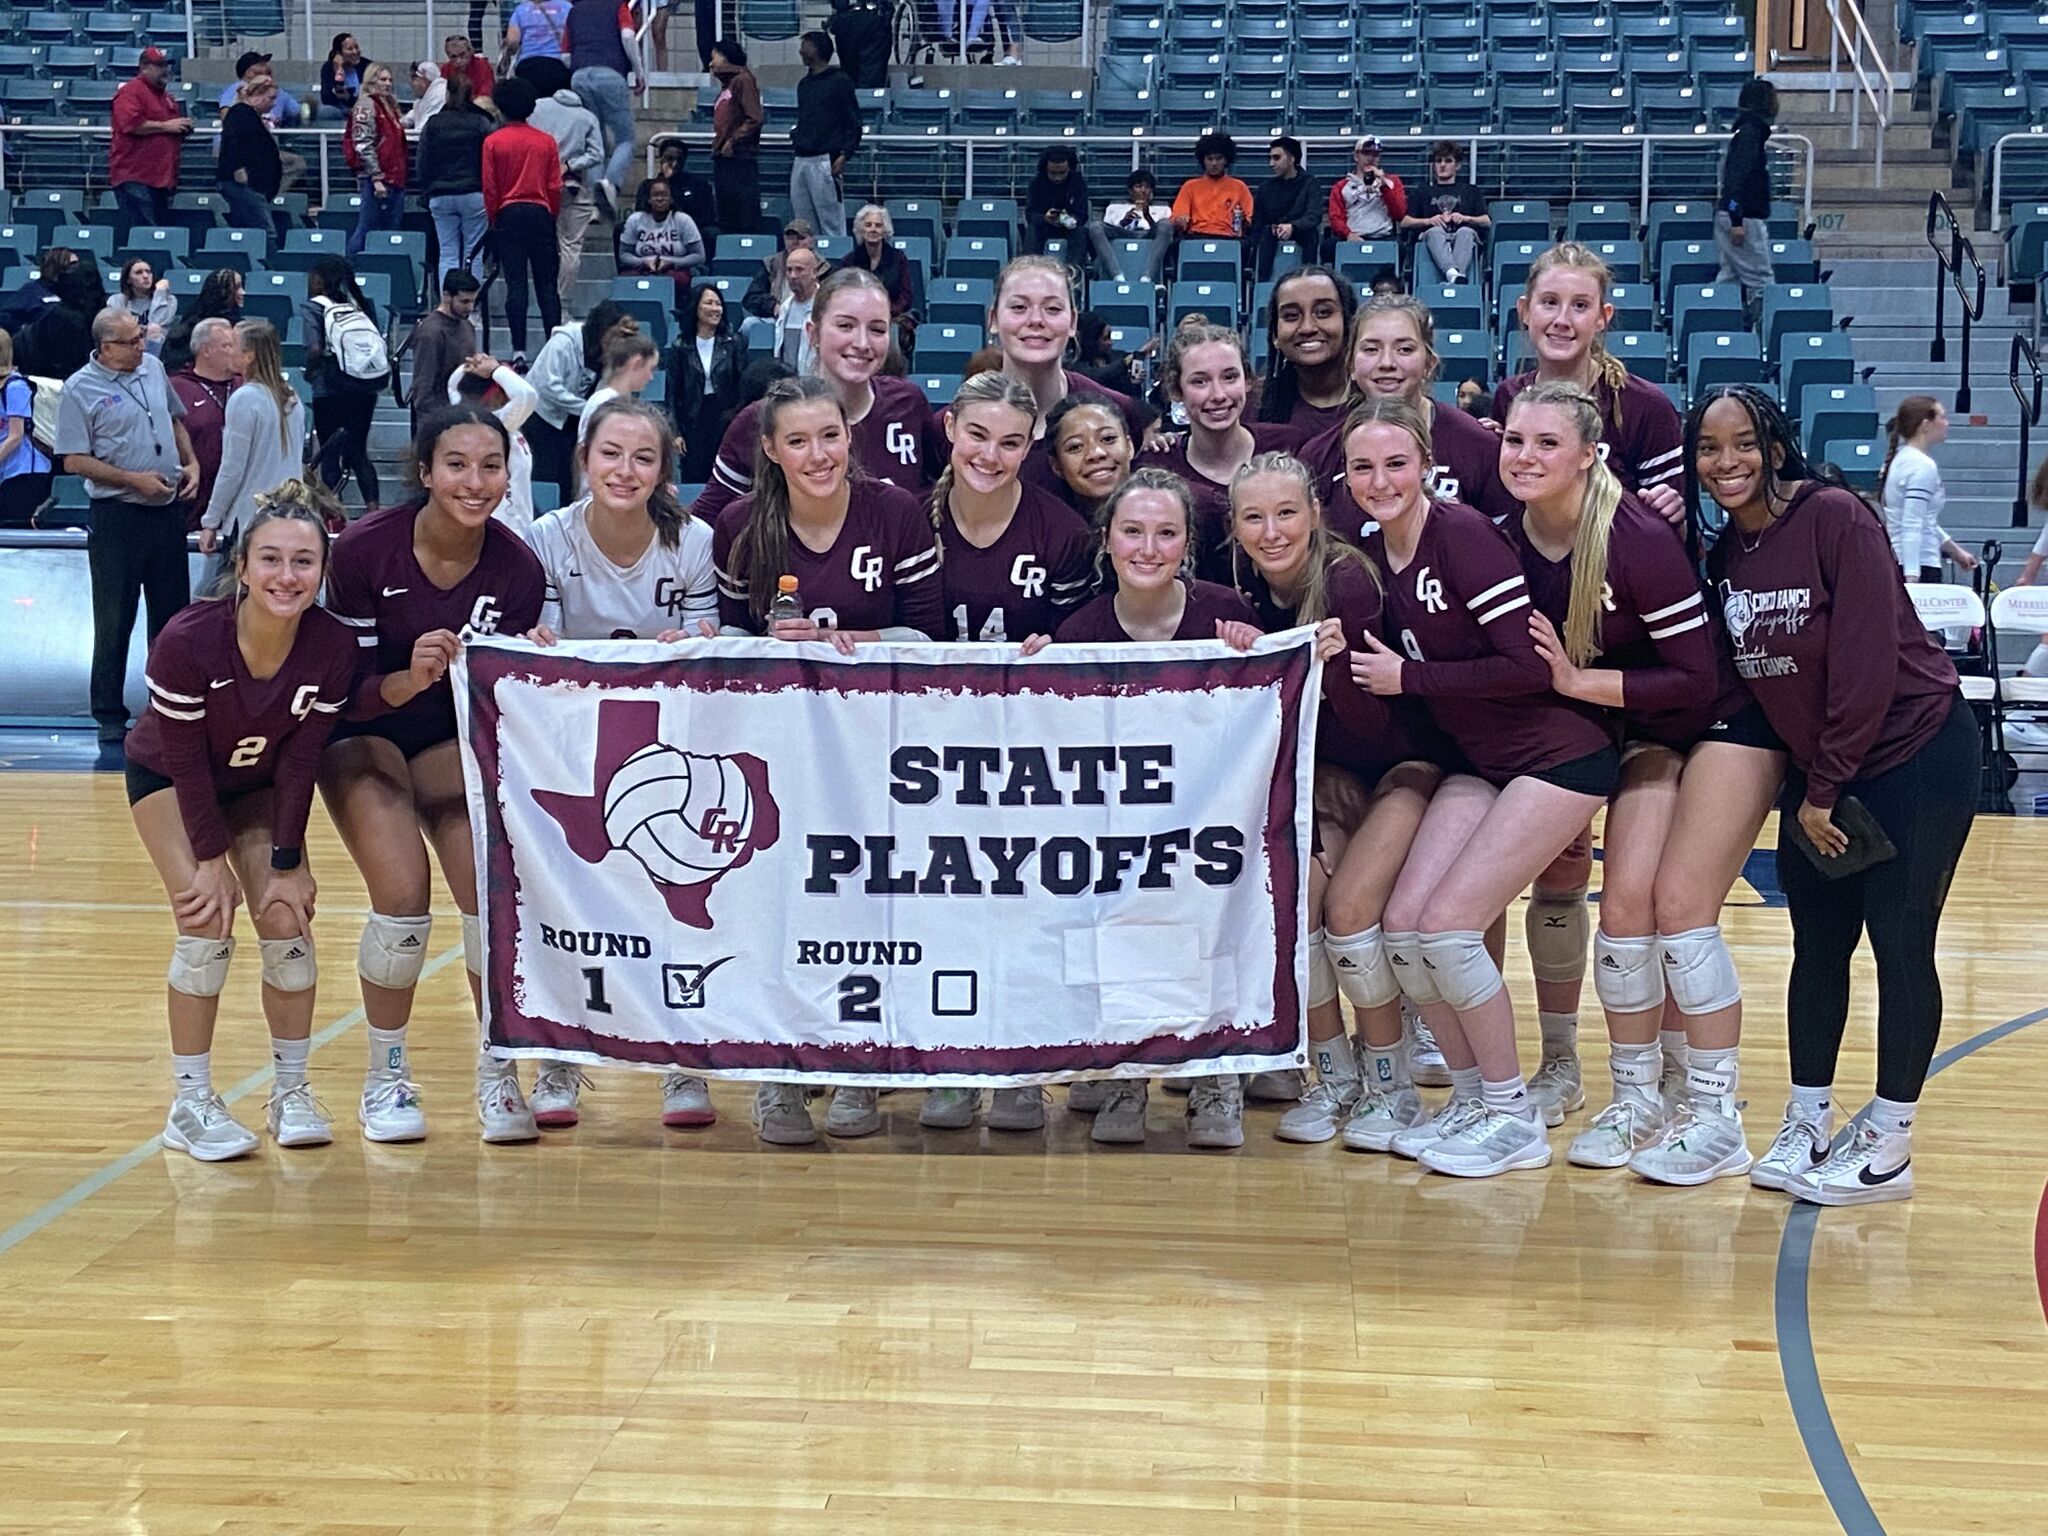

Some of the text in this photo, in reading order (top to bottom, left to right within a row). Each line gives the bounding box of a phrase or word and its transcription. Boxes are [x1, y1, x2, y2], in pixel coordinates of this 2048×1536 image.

[1815, 214, 1845, 231] 107
[886, 422, 917, 465] CR
[851, 546, 883, 592] CR
[1010, 554, 1047, 598] CR
[1416, 566, 1448, 613] CR
[952, 604, 1007, 642] 14
[228, 736, 267, 768] 2
[890, 744, 1174, 806] STATE
[700, 808, 740, 853] CR
[804, 826, 1245, 897] PLAYOFFS
[539, 922, 652, 959] ROUND
[797, 940, 922, 965] ROUND
[581, 966, 613, 1015] 1
[837, 974, 882, 1023] 2
